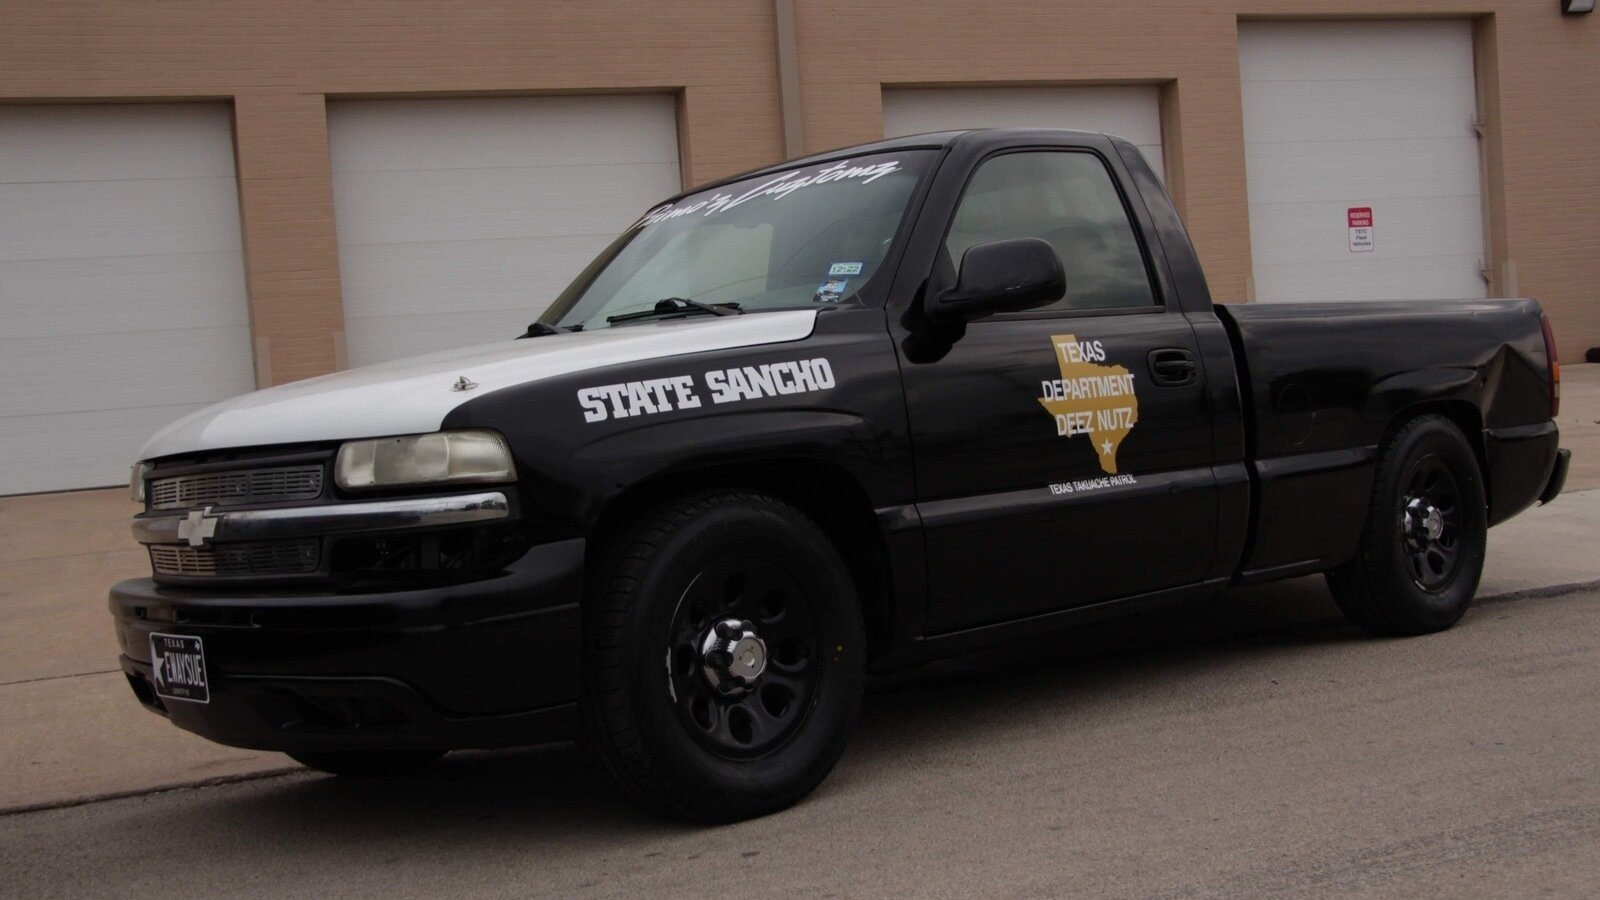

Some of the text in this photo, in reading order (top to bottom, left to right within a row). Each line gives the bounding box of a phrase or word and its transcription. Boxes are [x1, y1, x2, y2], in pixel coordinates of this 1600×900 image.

[1057, 340, 1106, 363] TEXAS
[577, 357, 836, 423] STATE SANCHO
[1041, 374, 1135, 402] DEPARTMENT
[1055, 407, 1134, 436] DEEZ NUTZ
[1049, 474, 1136, 495] TEXAS TAKUACHE PATROL
[164, 638, 185, 649] TEXAS
[164, 651, 205, 687] EMAYSUE
